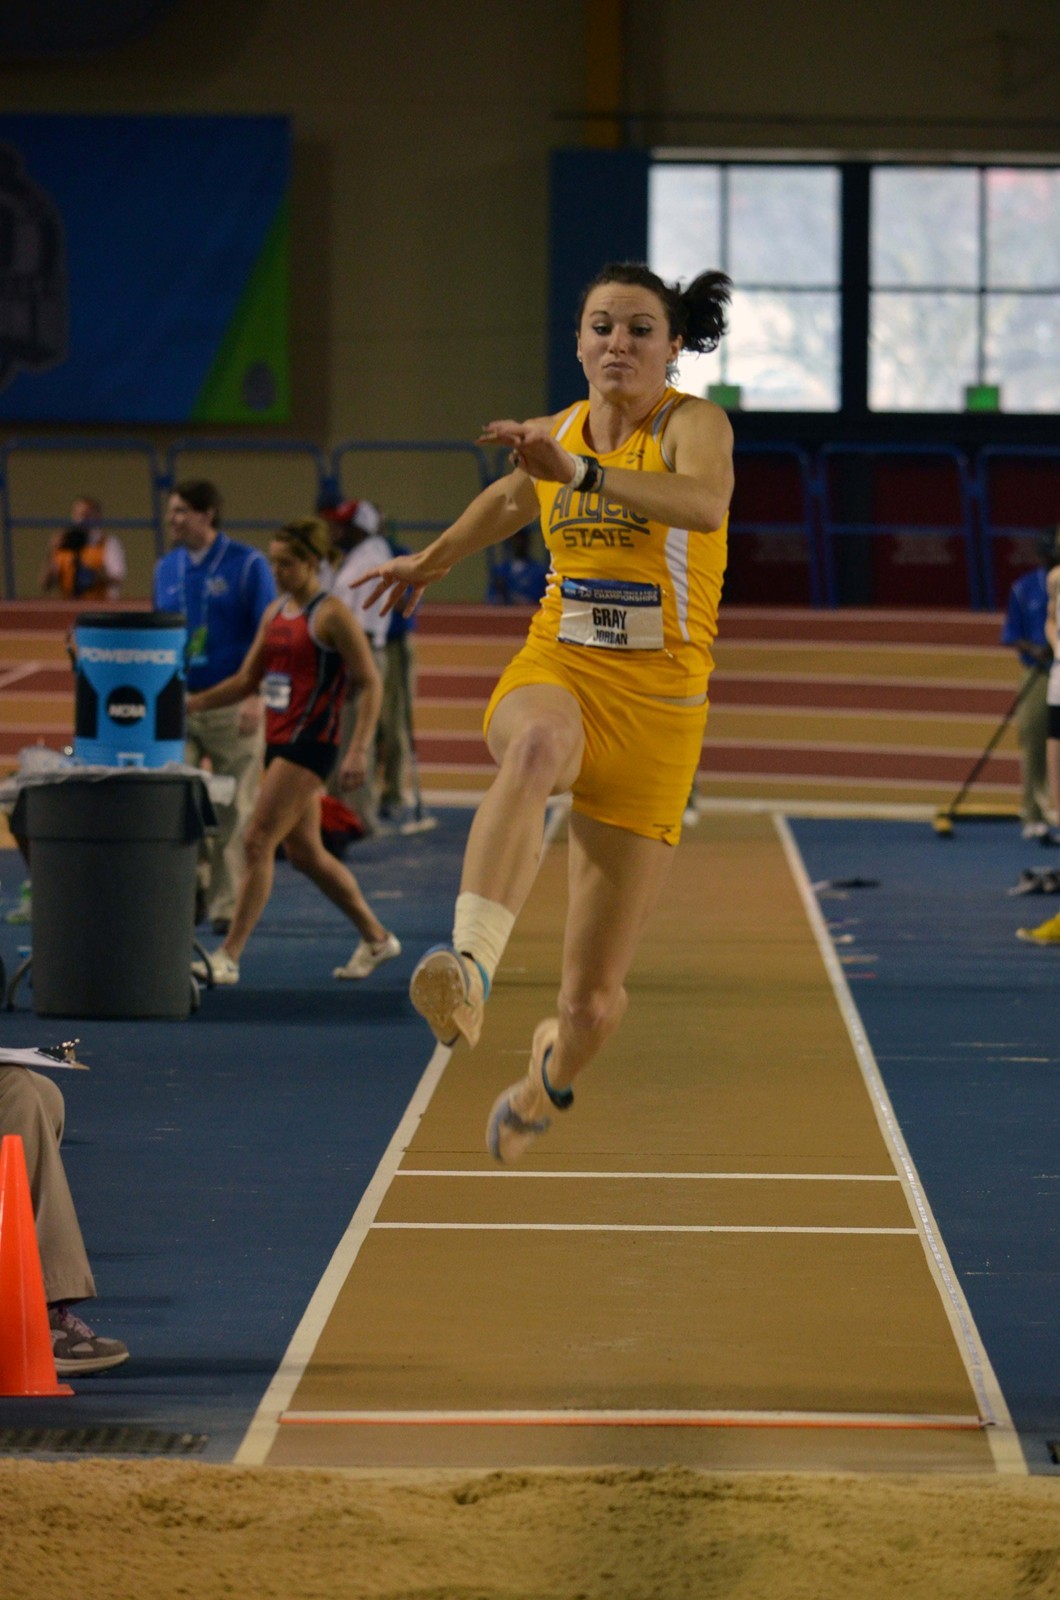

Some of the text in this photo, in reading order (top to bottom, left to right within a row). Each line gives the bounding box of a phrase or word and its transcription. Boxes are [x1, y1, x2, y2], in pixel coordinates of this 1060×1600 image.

[563, 528, 634, 548] STATE
[592, 607, 627, 630] GRAY
[593, 629, 628, 645] JORDAN
[108, 703, 146, 718] NCAA
